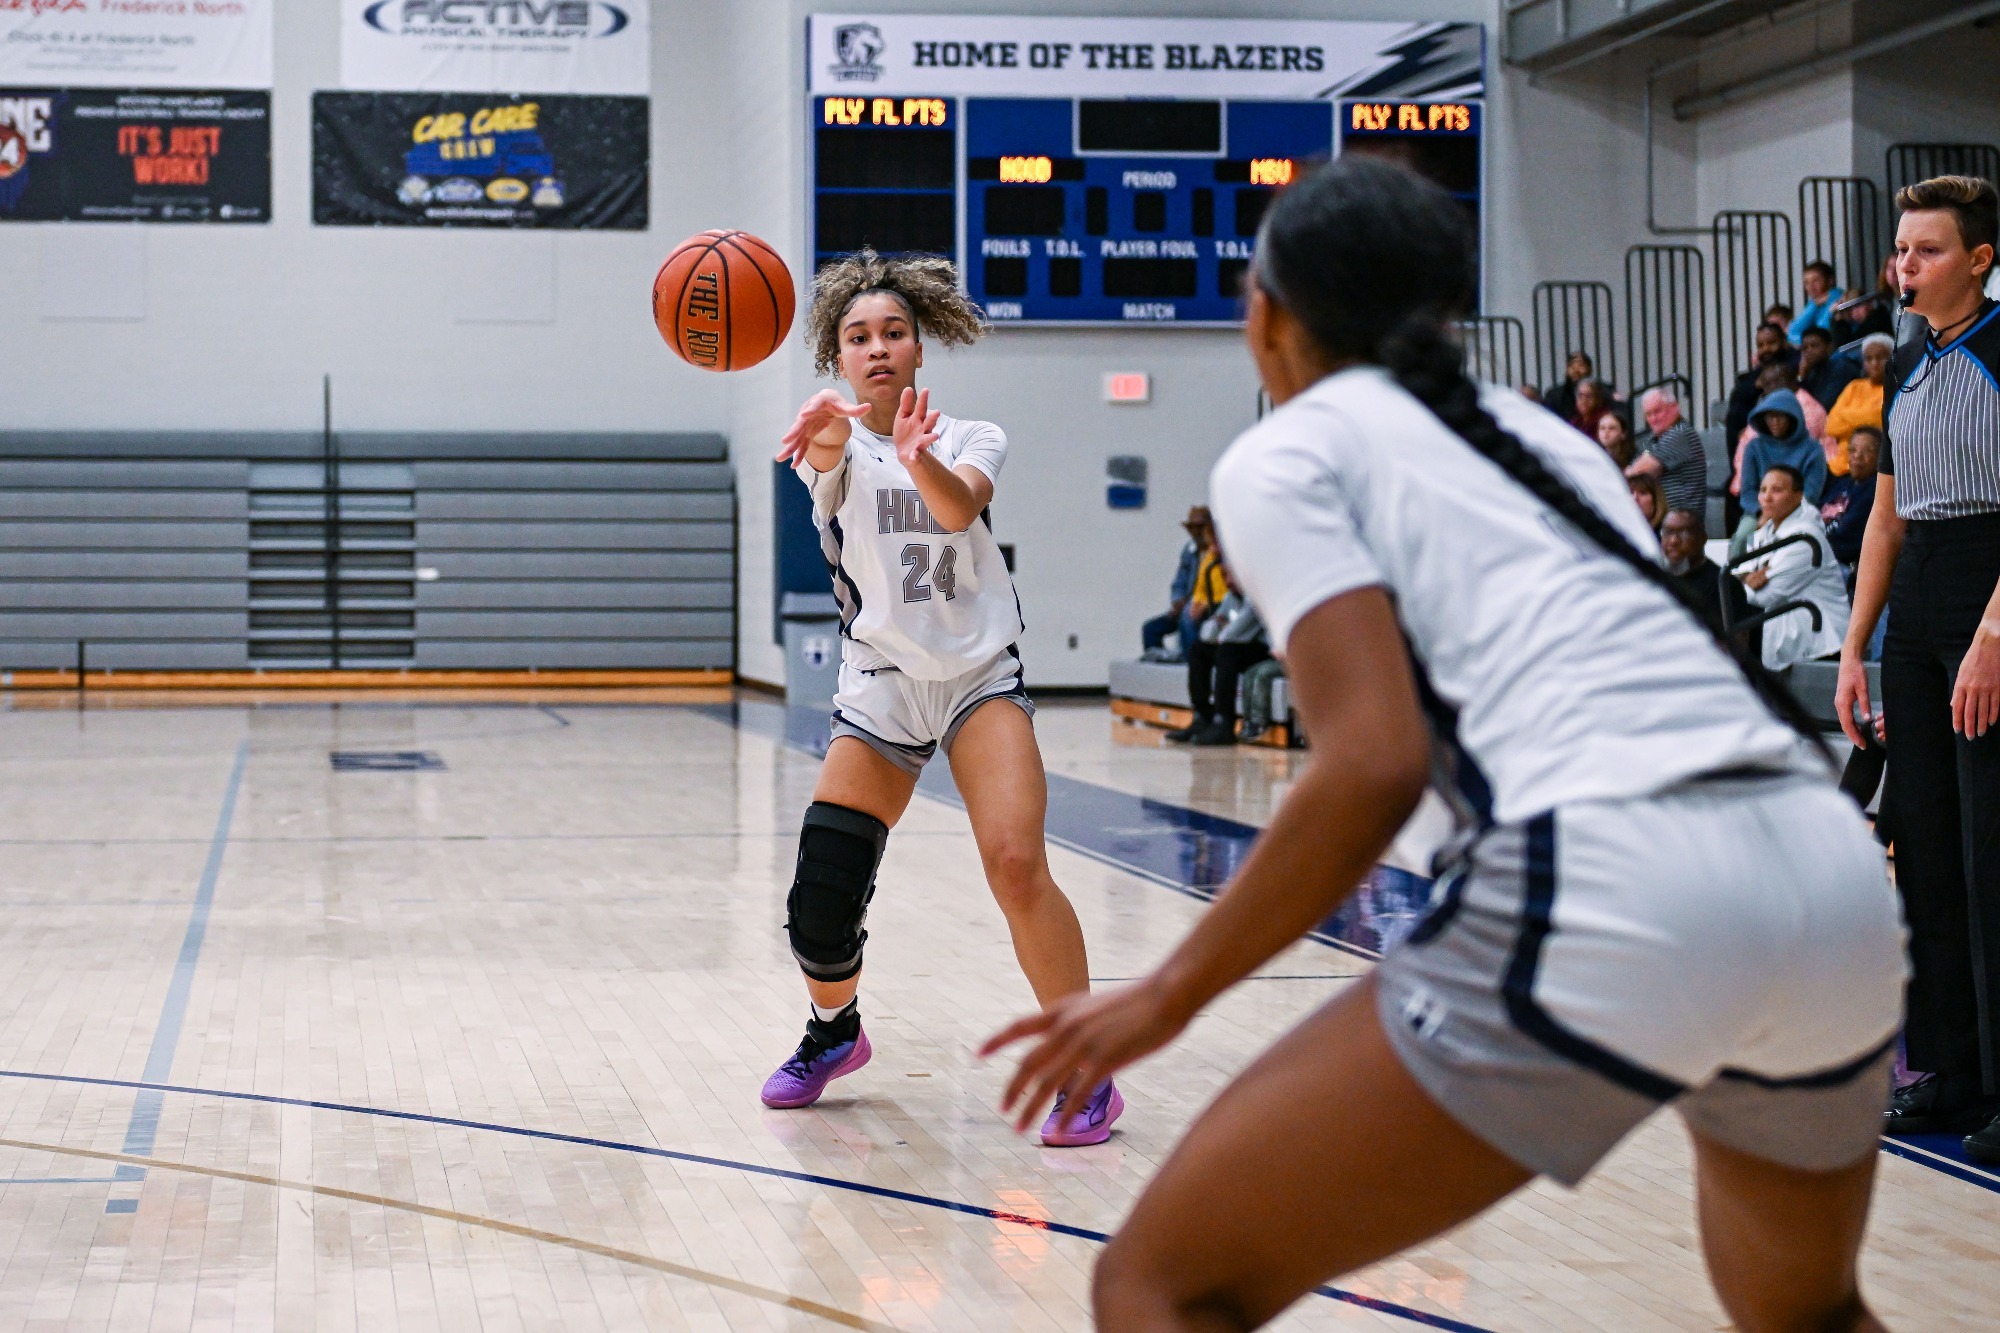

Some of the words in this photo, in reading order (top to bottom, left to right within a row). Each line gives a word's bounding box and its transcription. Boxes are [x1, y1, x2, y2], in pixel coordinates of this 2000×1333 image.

[914, 42, 1018, 68] HOME
[1029, 43, 1072, 69] OF
[1082, 43, 1154, 70] THE
[1164, 44, 1324, 72] BLAZERS
[412, 111, 467, 144] CAR
[469, 101, 541, 136] CARE
[903, 98, 946, 125] PTS
[1428, 104, 1470, 130] PTS
[118, 125, 162, 156] IT'S
[167, 126, 222, 157] JUST
[1122, 170, 1177, 190] PERIOD
[981, 238, 1032, 258] FOULS
[1101, 239, 1158, 259] PLAYER
[1160, 240, 1200, 259] FOUL
[687, 271, 719, 321] THE
[985, 302, 1023, 319] WON
[1122, 303, 1176, 320] MATCH
[900, 543, 958, 603] 24
